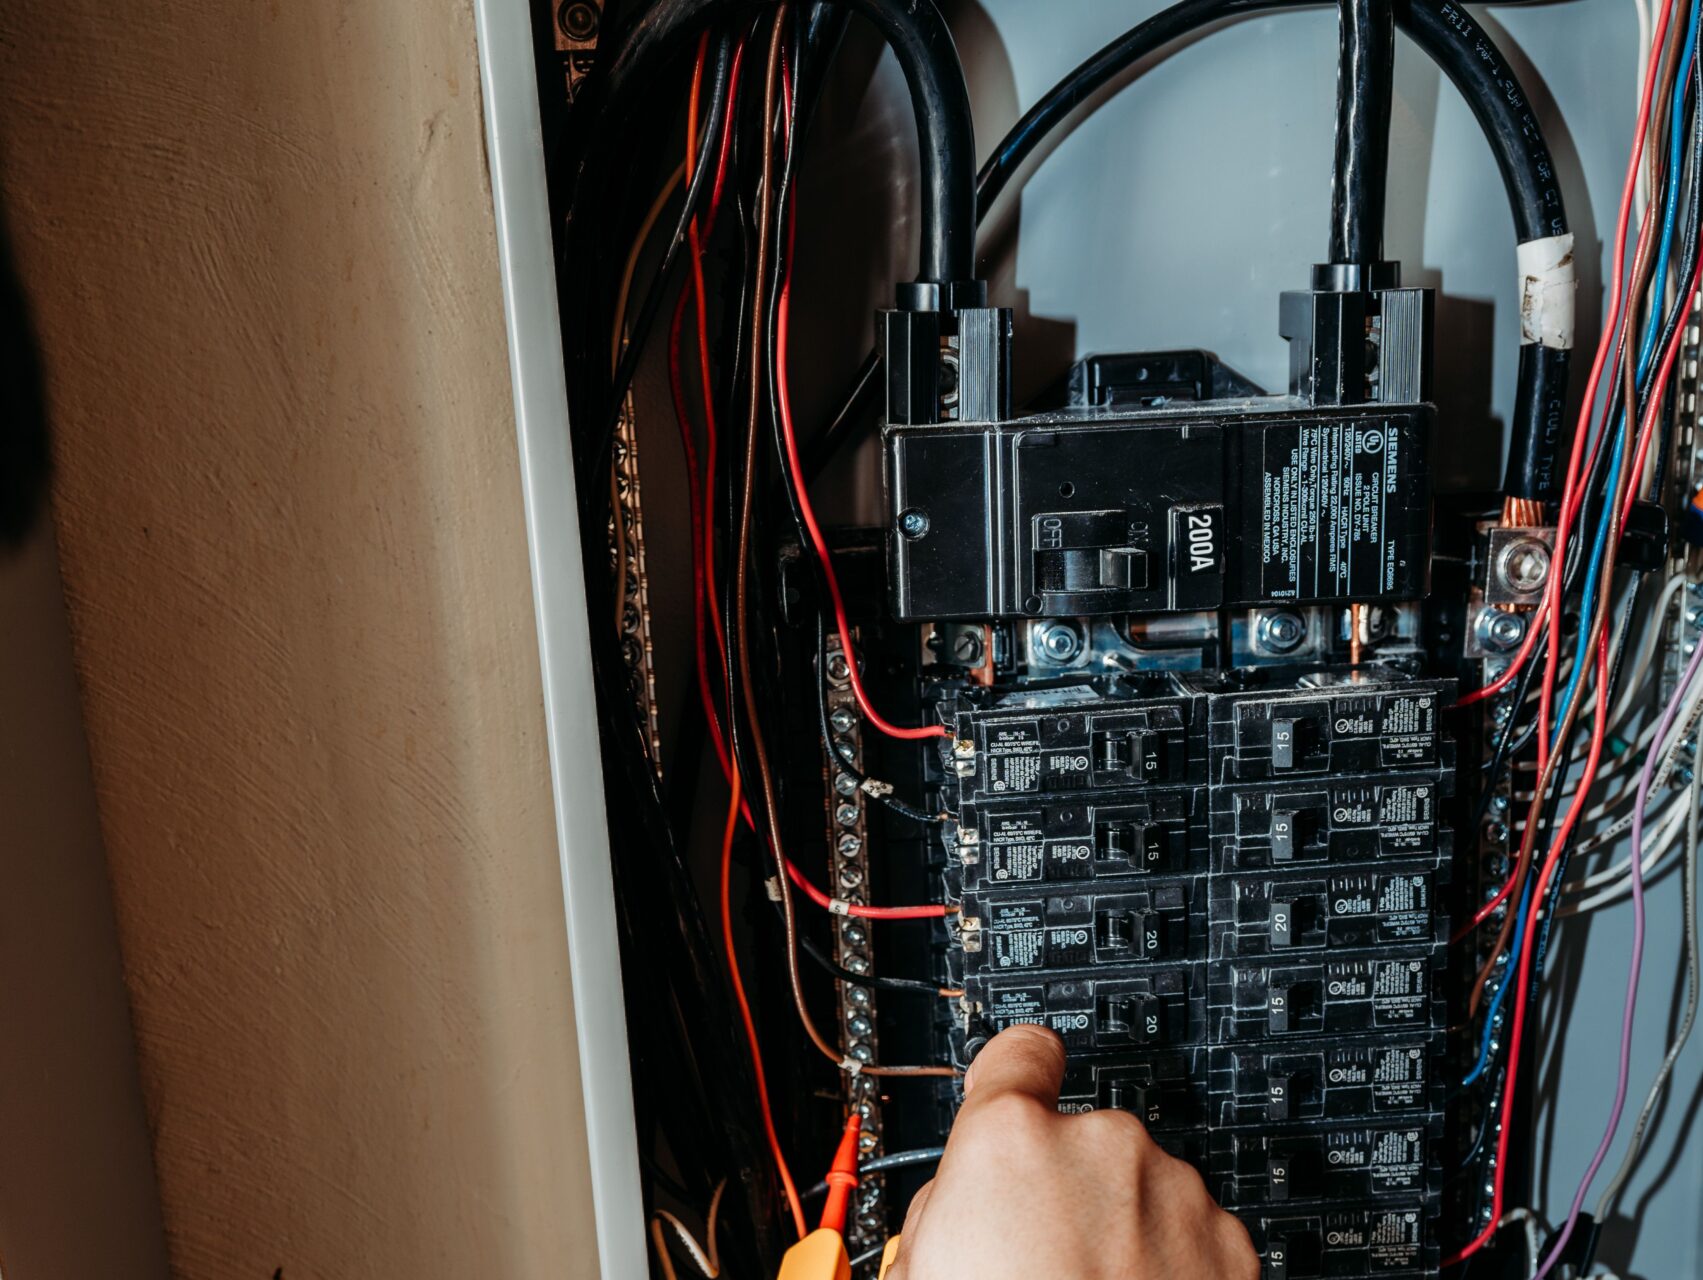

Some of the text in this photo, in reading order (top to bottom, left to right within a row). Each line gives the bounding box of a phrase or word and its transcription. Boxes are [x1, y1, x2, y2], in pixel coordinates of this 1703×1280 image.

[1321, 428, 1329, 472] Symmetrical
[1330, 427, 1338, 469] Interrupting
[1387, 428, 1398, 493] SIEMENS
[1330, 471, 1338, 494] Rating
[1272, 477, 1280, 524] NORCROSS,
[1291, 490, 1297, 499] IN
[1043, 519, 1062, 548] OFF
[1264, 522, 1270, 530] IN
[1273, 526, 1279, 537] GA
[1370, 506, 1378, 543] BREAKER
[1188, 514, 1214, 572] 200A
[1387, 540, 1395, 561] TYPE
[1277, 732, 1289, 750] 15
[1145, 752, 1156, 770] 15
[1276, 823, 1288, 841] 15
[1148, 843, 1159, 861] 15
[1275, 914, 1287, 931] 20
[1146, 931, 1157, 949] 20
[1272, 997, 1284, 1014] 15
[1146, 1015, 1157, 1034] 20
[1271, 1087, 1284, 1103] 15
[1149, 1105, 1159, 1121] 15
[1273, 1168, 1285, 1184] 15
[1271, 1251, 1283, 1267] 15
